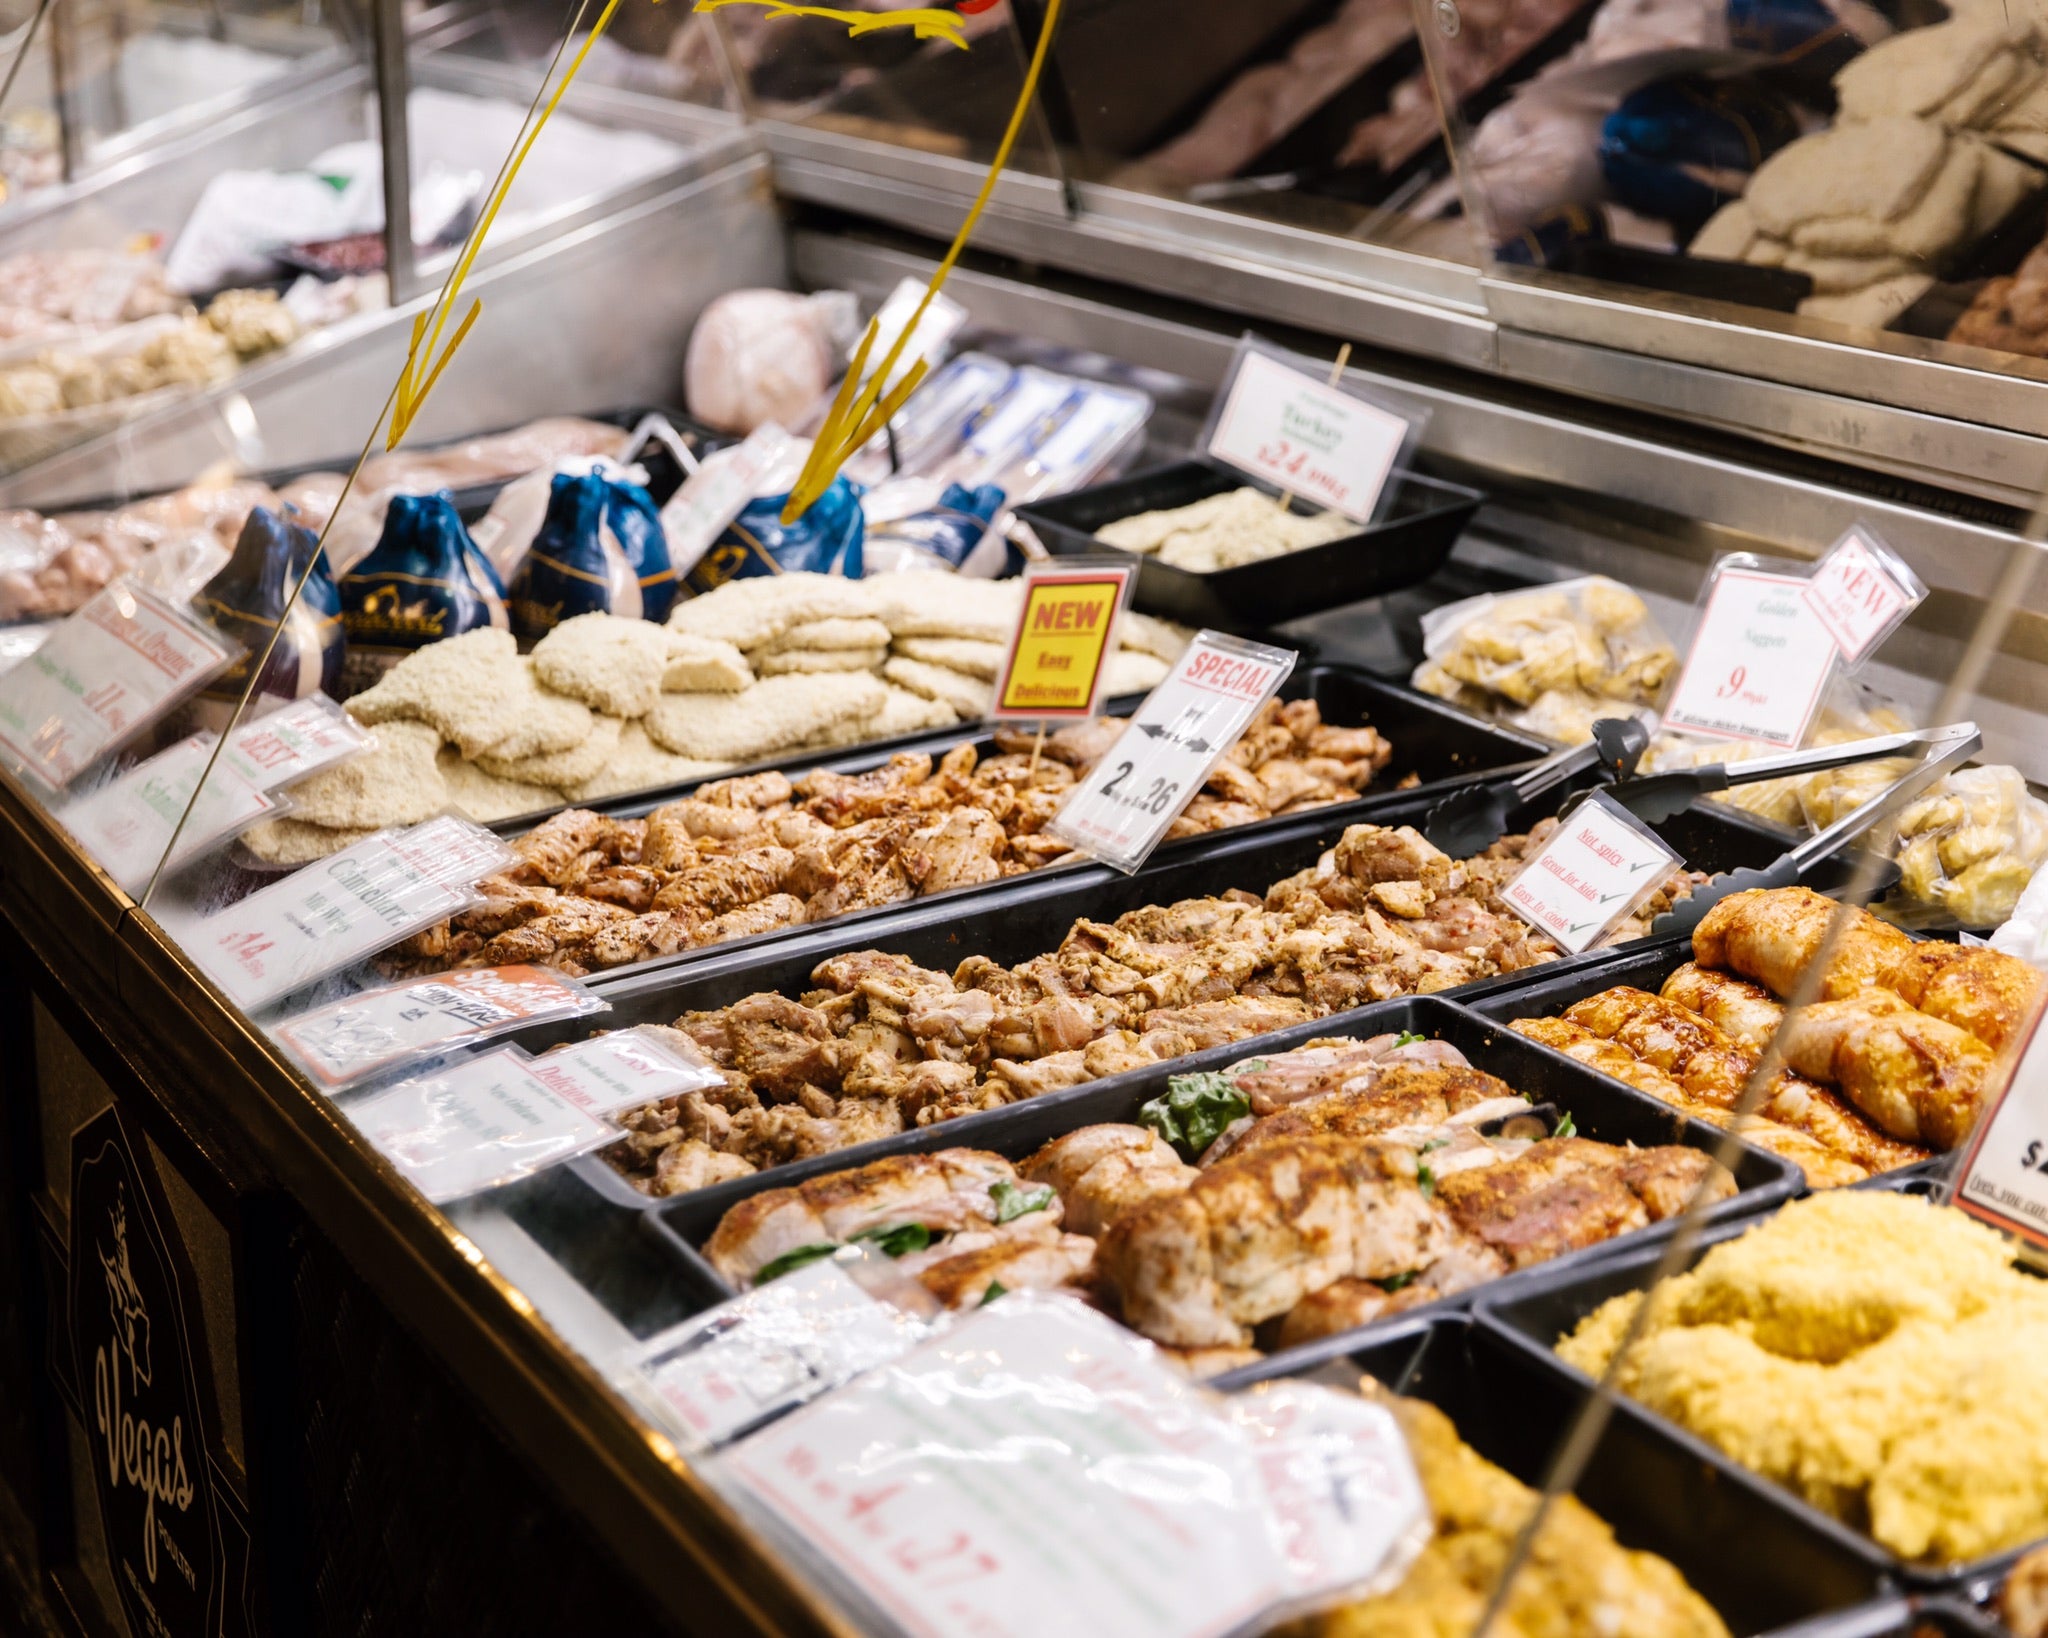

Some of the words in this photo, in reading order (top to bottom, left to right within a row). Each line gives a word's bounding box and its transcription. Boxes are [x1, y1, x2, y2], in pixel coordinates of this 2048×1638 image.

[1033, 601, 1103, 630] NEW
[1037, 652, 1073, 671] Easy
[1187, 651, 1273, 697] SPECIAL
[1577, 828, 1600, 848] Not
[1598, 843, 1625, 867] spicy
[1541, 855, 1564, 877] Great
[1562, 871, 1581, 889] for
[1578, 879, 1599, 901] kids
[1511, 884, 1535, 906] Easy
[1534, 901, 1545, 913] to
[1545, 909, 1570, 931] cook
[535, 1066, 597, 1107] Delicious
[96, 1335, 193, 1583] Vegas
[158, 1518, 196, 1592] POULTRY
